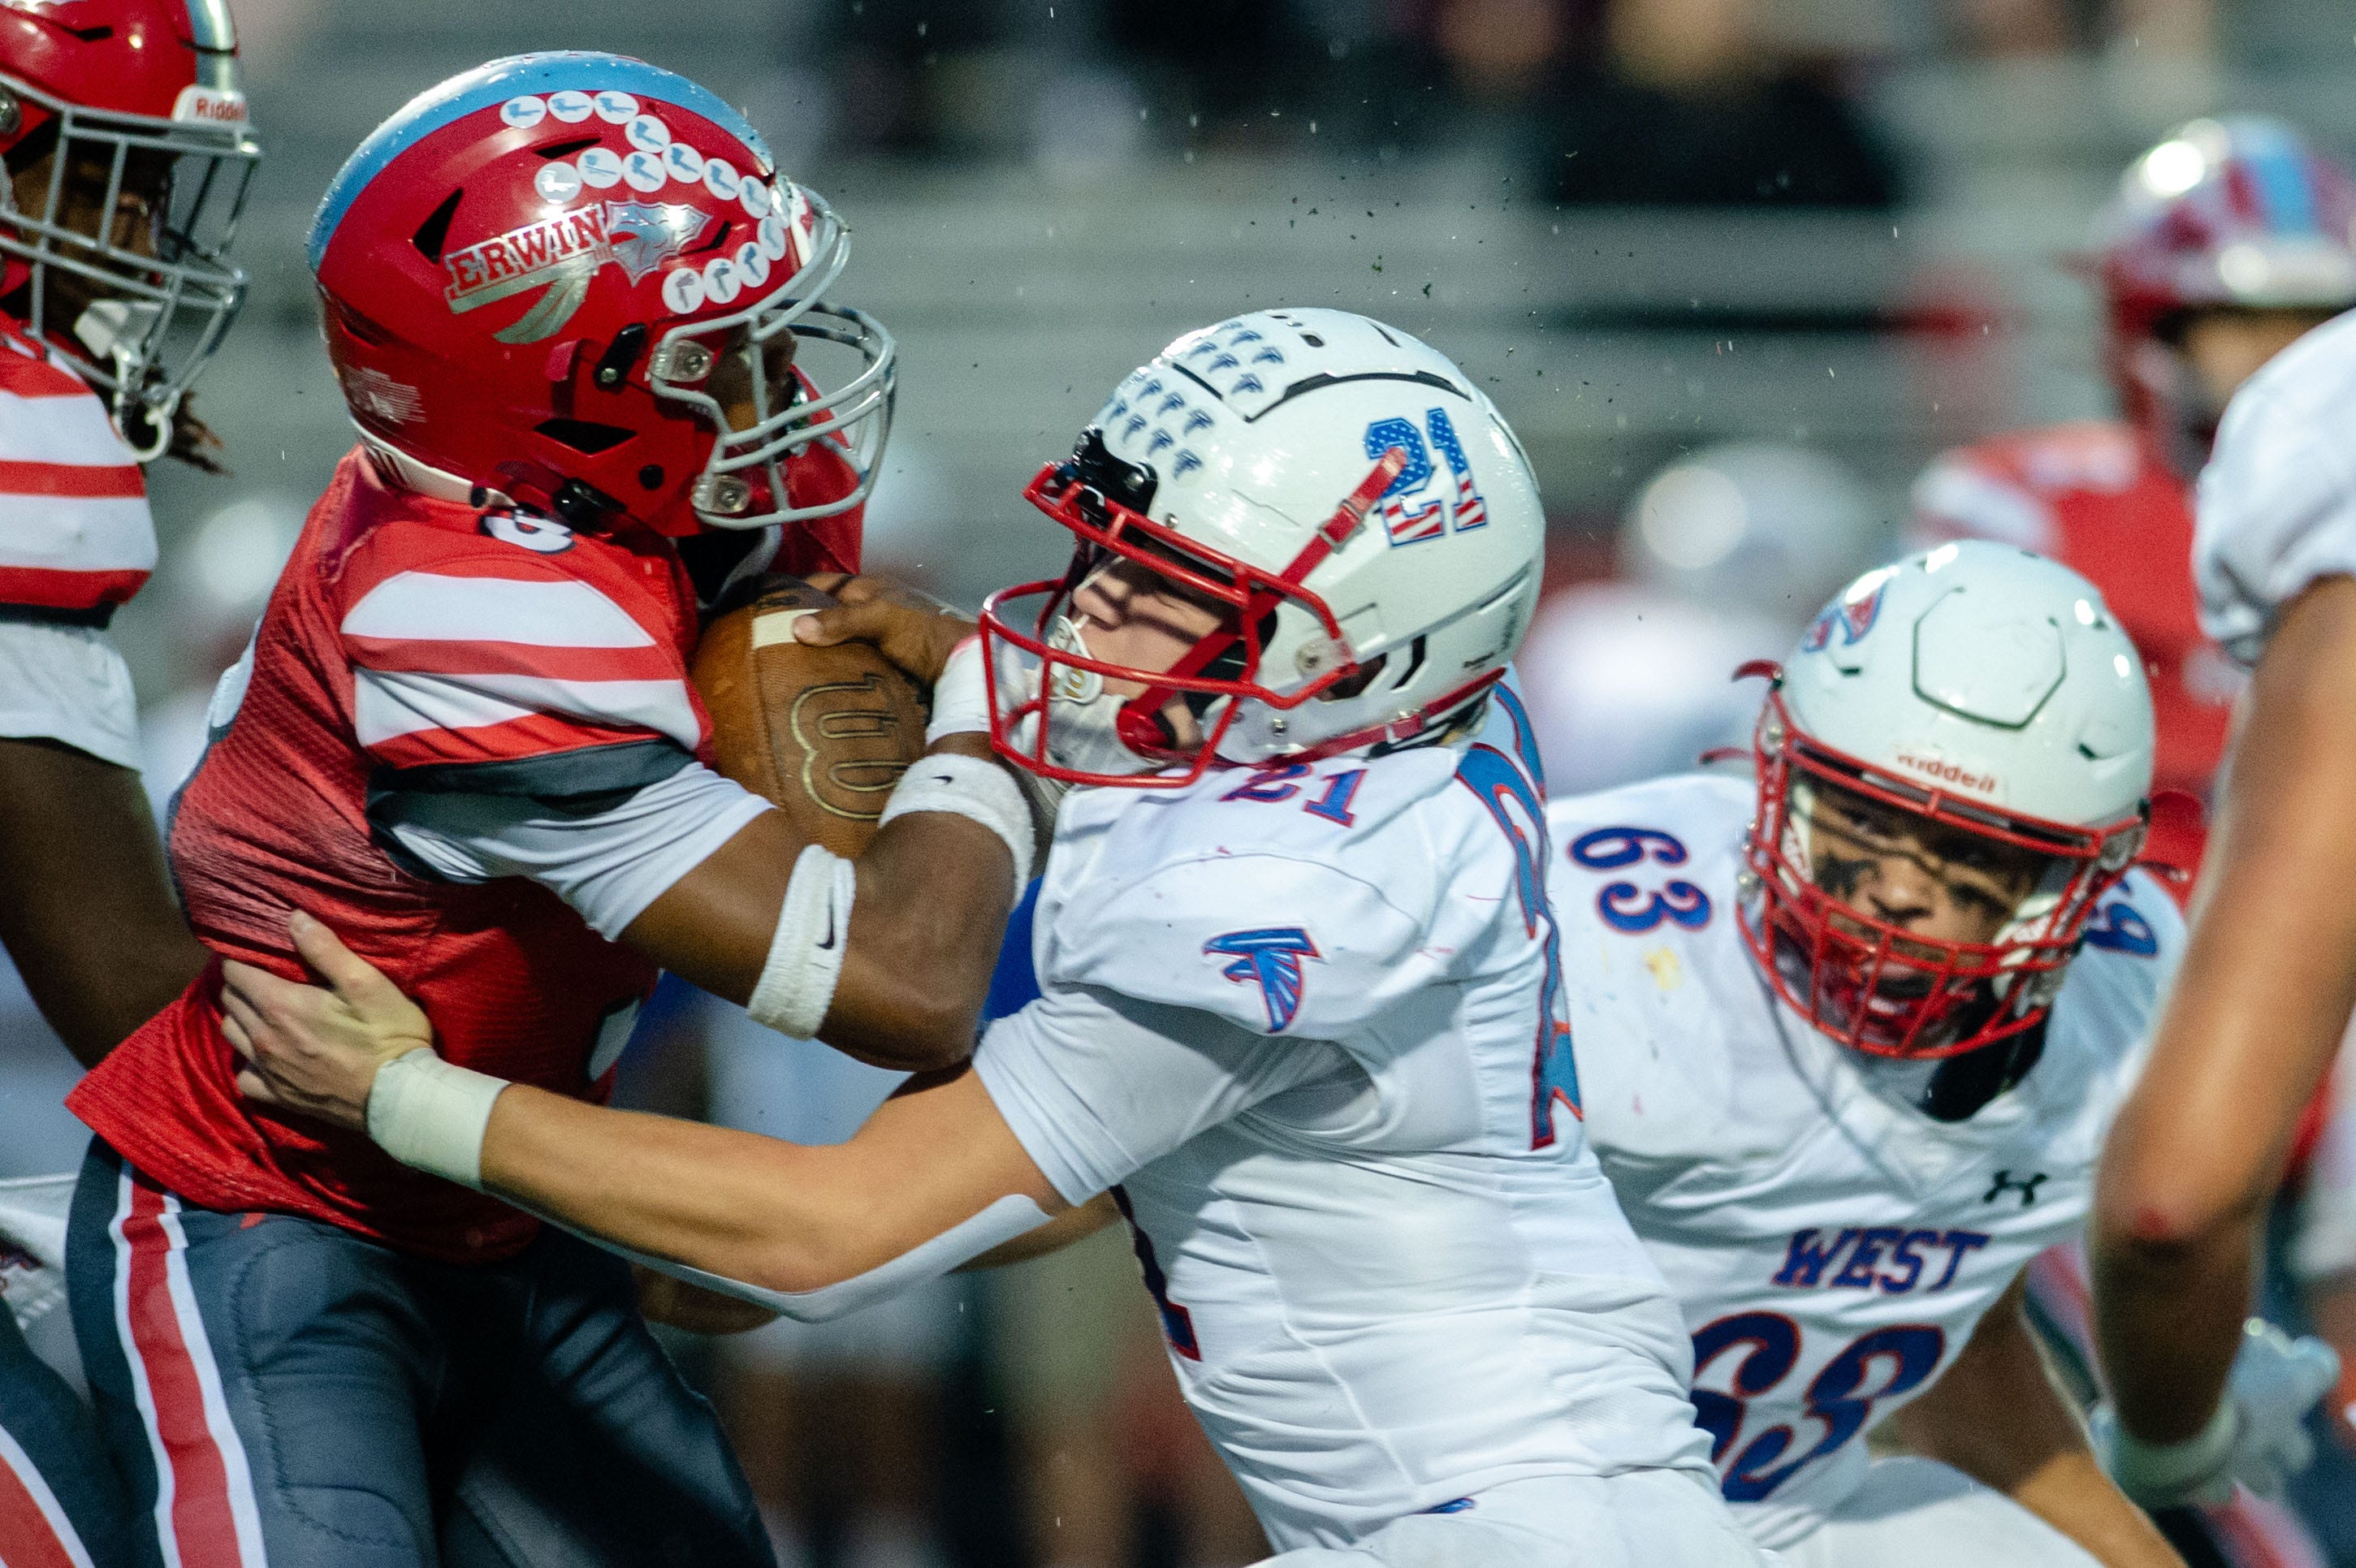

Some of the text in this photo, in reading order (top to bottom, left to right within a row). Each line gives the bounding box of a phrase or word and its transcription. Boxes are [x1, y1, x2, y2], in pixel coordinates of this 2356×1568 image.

[449, 209, 605, 291] ERWIN
[1365, 406, 1488, 547] 21
[1219, 762, 1369, 828] 21
[1566, 826, 1713, 934] 63
[1769, 1226, 1992, 1294] WEST
